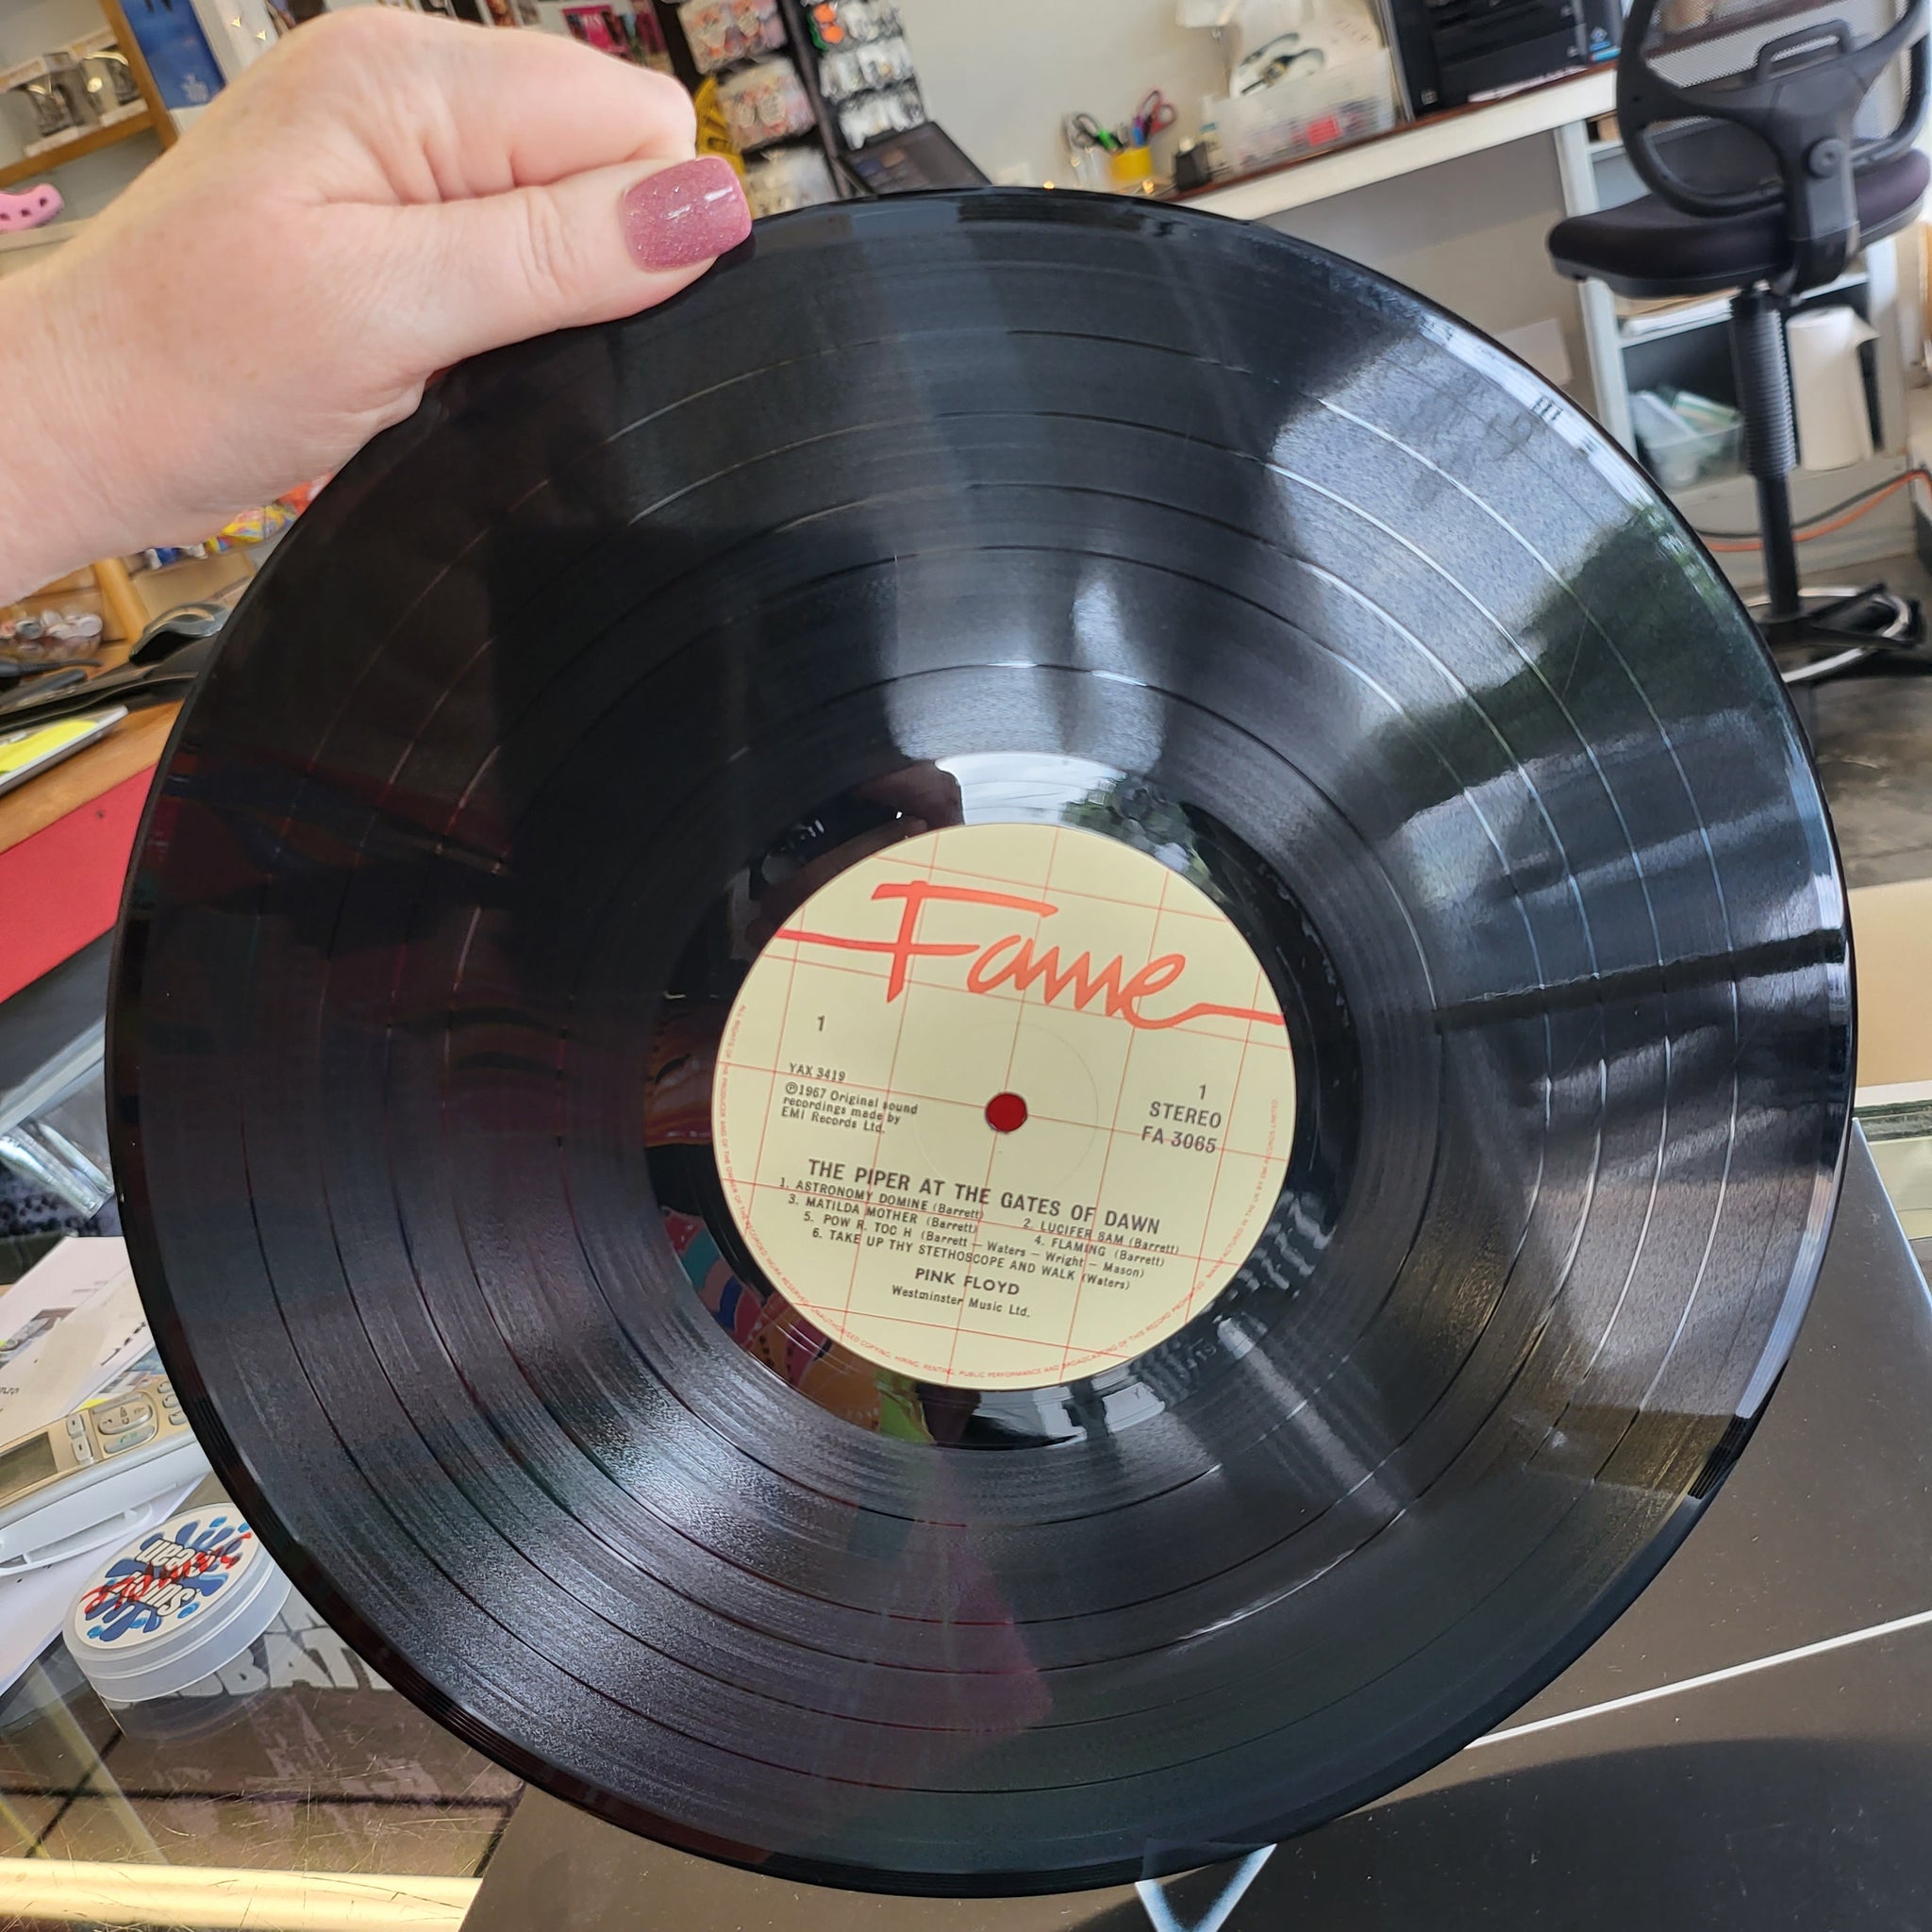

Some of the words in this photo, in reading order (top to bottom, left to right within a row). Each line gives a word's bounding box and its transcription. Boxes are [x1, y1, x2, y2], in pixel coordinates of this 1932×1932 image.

[776, 879, 1286, 1030] Fame
[818, 1015, 824, 1031] 1
[790, 1062, 812, 1077] YAX
[817, 1068, 845, 1083] 3419
[830, 1091, 878, 1108] Original
[883, 1102, 918, 1114] sound
[1198, 1083, 1207, 1100] 1
[781, 1106, 805, 1120] EMI
[811, 1111, 857, 1128] Records
[863, 1120, 884, 1134] Ltd.
[783, 1097, 845, 1115] recordings
[851, 1108, 883, 1120] made
[887, 1112, 900, 1124] by
[1149, 1101, 1222, 1128] STEREO
[1141, 1124, 1164, 1144] FA
[1171, 1131, 1217, 1154] 3065
[777, 1177, 791, 1191] 1.
[794, 1180, 873, 1204] ASTRONOMY
[877, 1193, 928, 1213] DOMINE
[930, 1203, 983, 1223] (Barrett)
[789, 1190, 803, 1205] 3.
[806, 1192, 859, 1214] MATILDA
[864, 1203, 918, 1224] MOTHER
[926, 1217, 977, 1233] (Barrett)
[808, 1158, 845, 1180] THE
[855, 1167, 910, 1191] PIPER
[919, 1178, 945, 1196] AT
[955, 1183, 991, 1205] THE
[1001, 1192, 1060, 1216] GATES
[1071, 1205, 1096, 1222] OF
[1105, 1210, 1159, 1235] DAWN
[804, 1211, 813, 1222] 5.
[824, 1214, 850, 1226] POW
[875, 1222, 897, 1235] TOC
[903, 1227, 912, 1237] H
[922, 1231, 967, 1247] (Barrett
[988, 1241, 1025, 1257] Waters
[1046, 1252, 1083, 1267] Wright
[1103, 1262, 1144, 1278] Mason)
[1034, 1235, 1044, 1245] 4.
[1051, 1238, 1106, 1257] FLAMING
[1115, 1250, 1164, 1267] (Barrett)
[1039, 1221, 1092, 1241] LUCIFER
[1098, 1232, 1124, 1245] SAM
[1128, 1238, 1178, 1255] (Barrett)
[812, 1227, 822, 1238] 6.
[830, 1229, 861, 1245] TAKE
[867, 1236, 884, 1247] UP
[890, 1240, 913, 1252] THY
[919, 1244, 1005, 1268] STETHOSCOPE
[1009, 1260, 1036, 1273] AND
[1042, 1265, 1075, 1280] WALK
[1080, 1274, 1129, 1290] (Waters)
[915, 1268, 956, 1285] PINK
[963, 1275, 1020, 1294] FLOYD
[892, 1285, 964, 1305] Westminster
[968, 1297, 1002, 1312] Music
[1008, 1304, 1029, 1317] Ltd.
